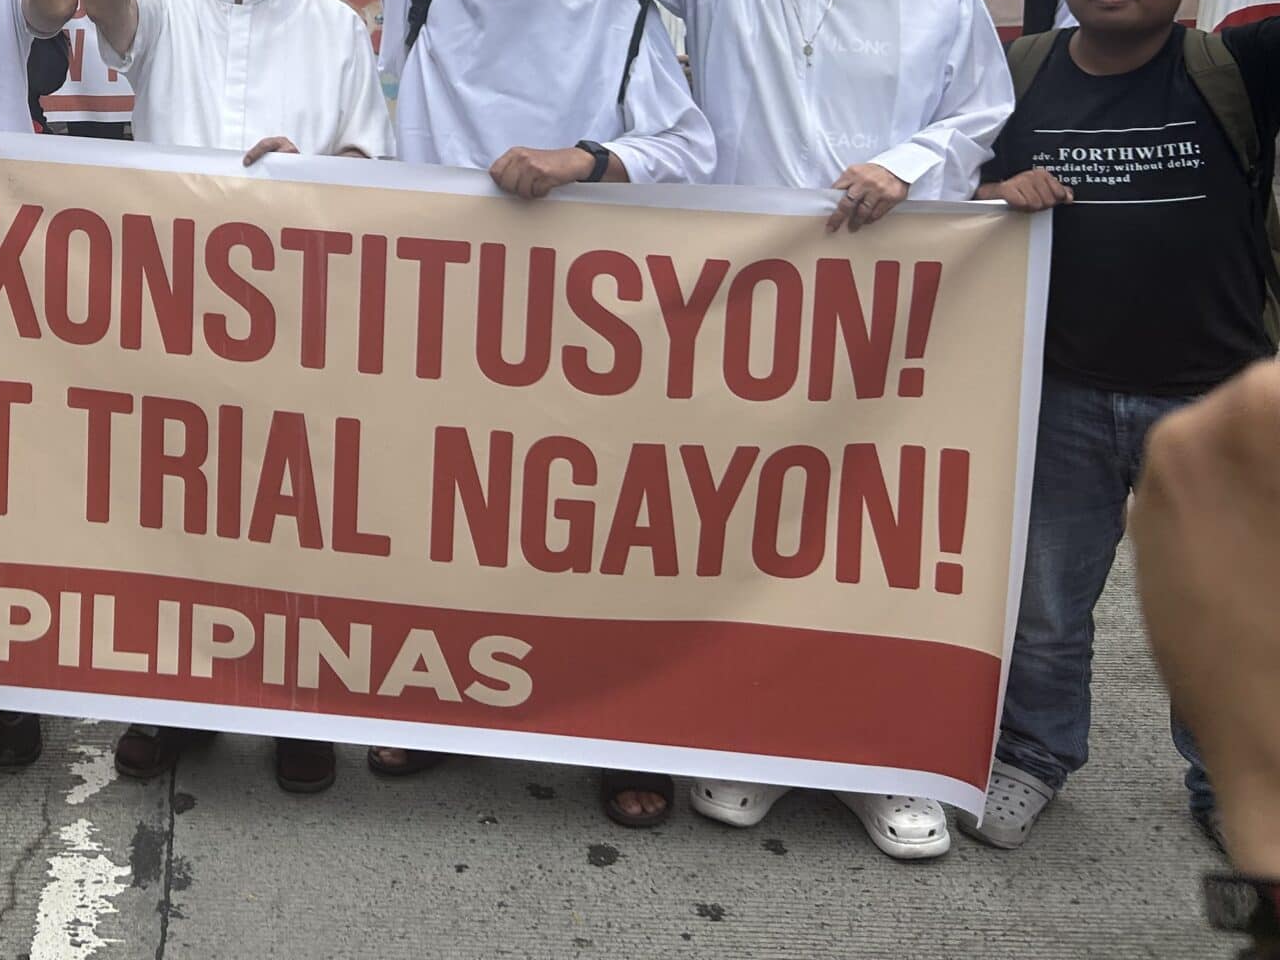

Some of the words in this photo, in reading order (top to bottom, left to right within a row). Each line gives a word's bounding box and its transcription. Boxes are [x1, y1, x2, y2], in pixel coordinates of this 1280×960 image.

[1032, 152, 1054, 161] adv.
[1058, 141, 1201, 161] FORTHWITH:
[1114, 161, 1163, 172] without
[1085, 173, 1131, 186] kaagad
[66, 386, 392, 558] TRIAL
[429, 425, 971, 596] NGAYON!
